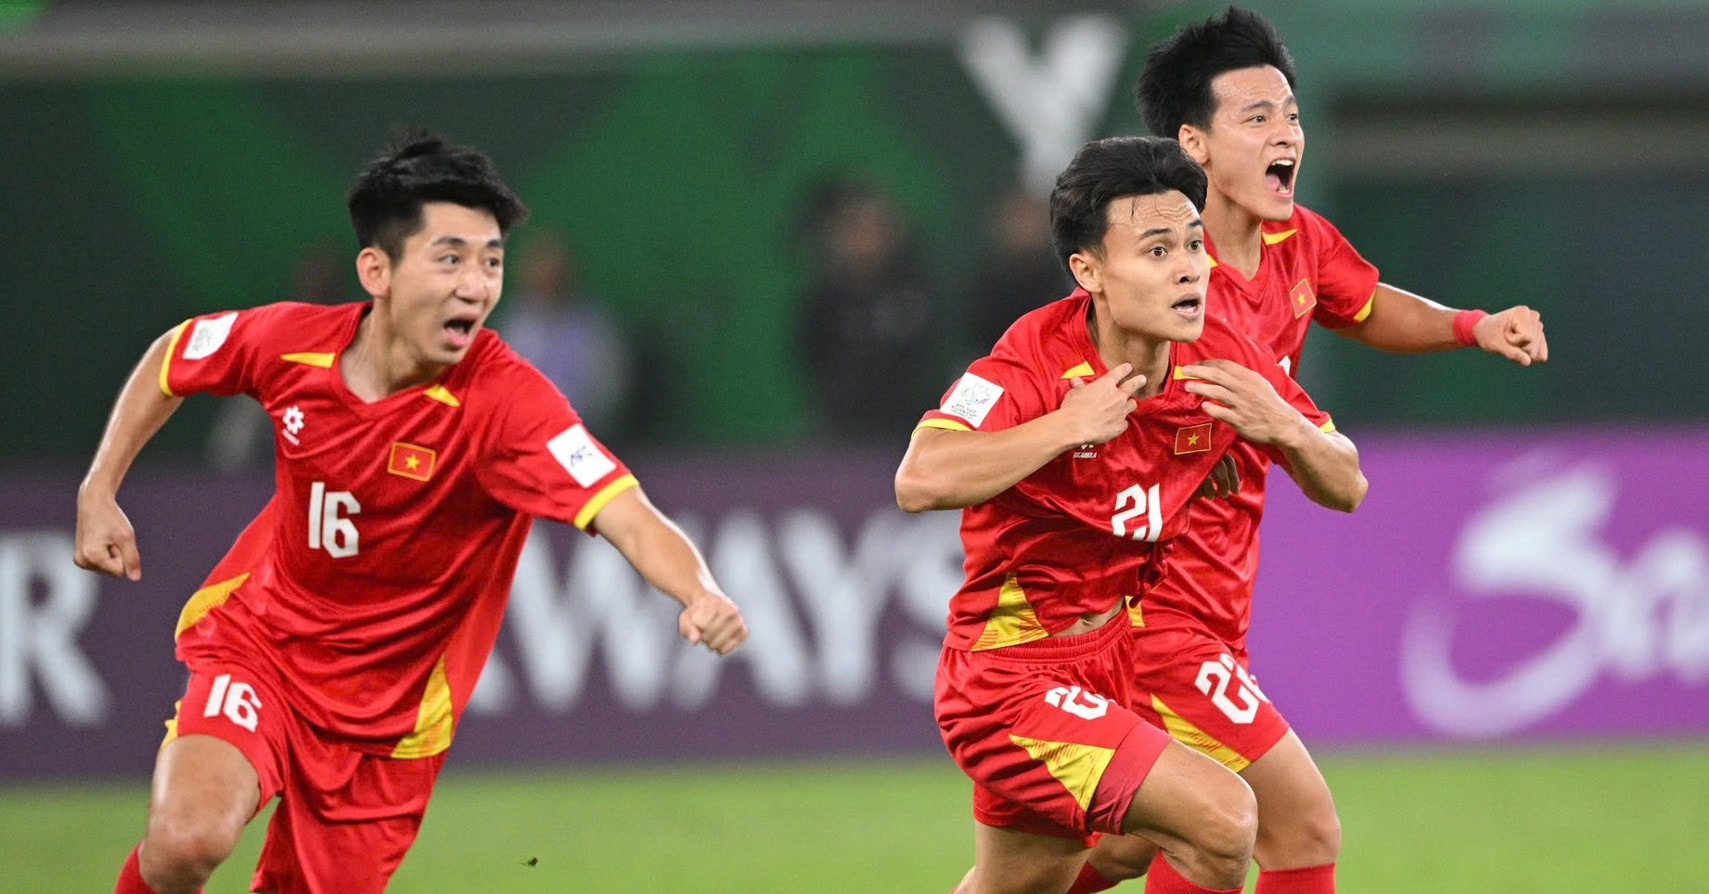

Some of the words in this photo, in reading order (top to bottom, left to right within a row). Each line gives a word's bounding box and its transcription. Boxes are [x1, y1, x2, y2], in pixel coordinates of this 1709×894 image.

[308, 481, 361, 558] 16
[1111, 482, 1163, 542] 21
[465, 508, 968, 712] WAYS
[203, 673, 263, 733] 16
